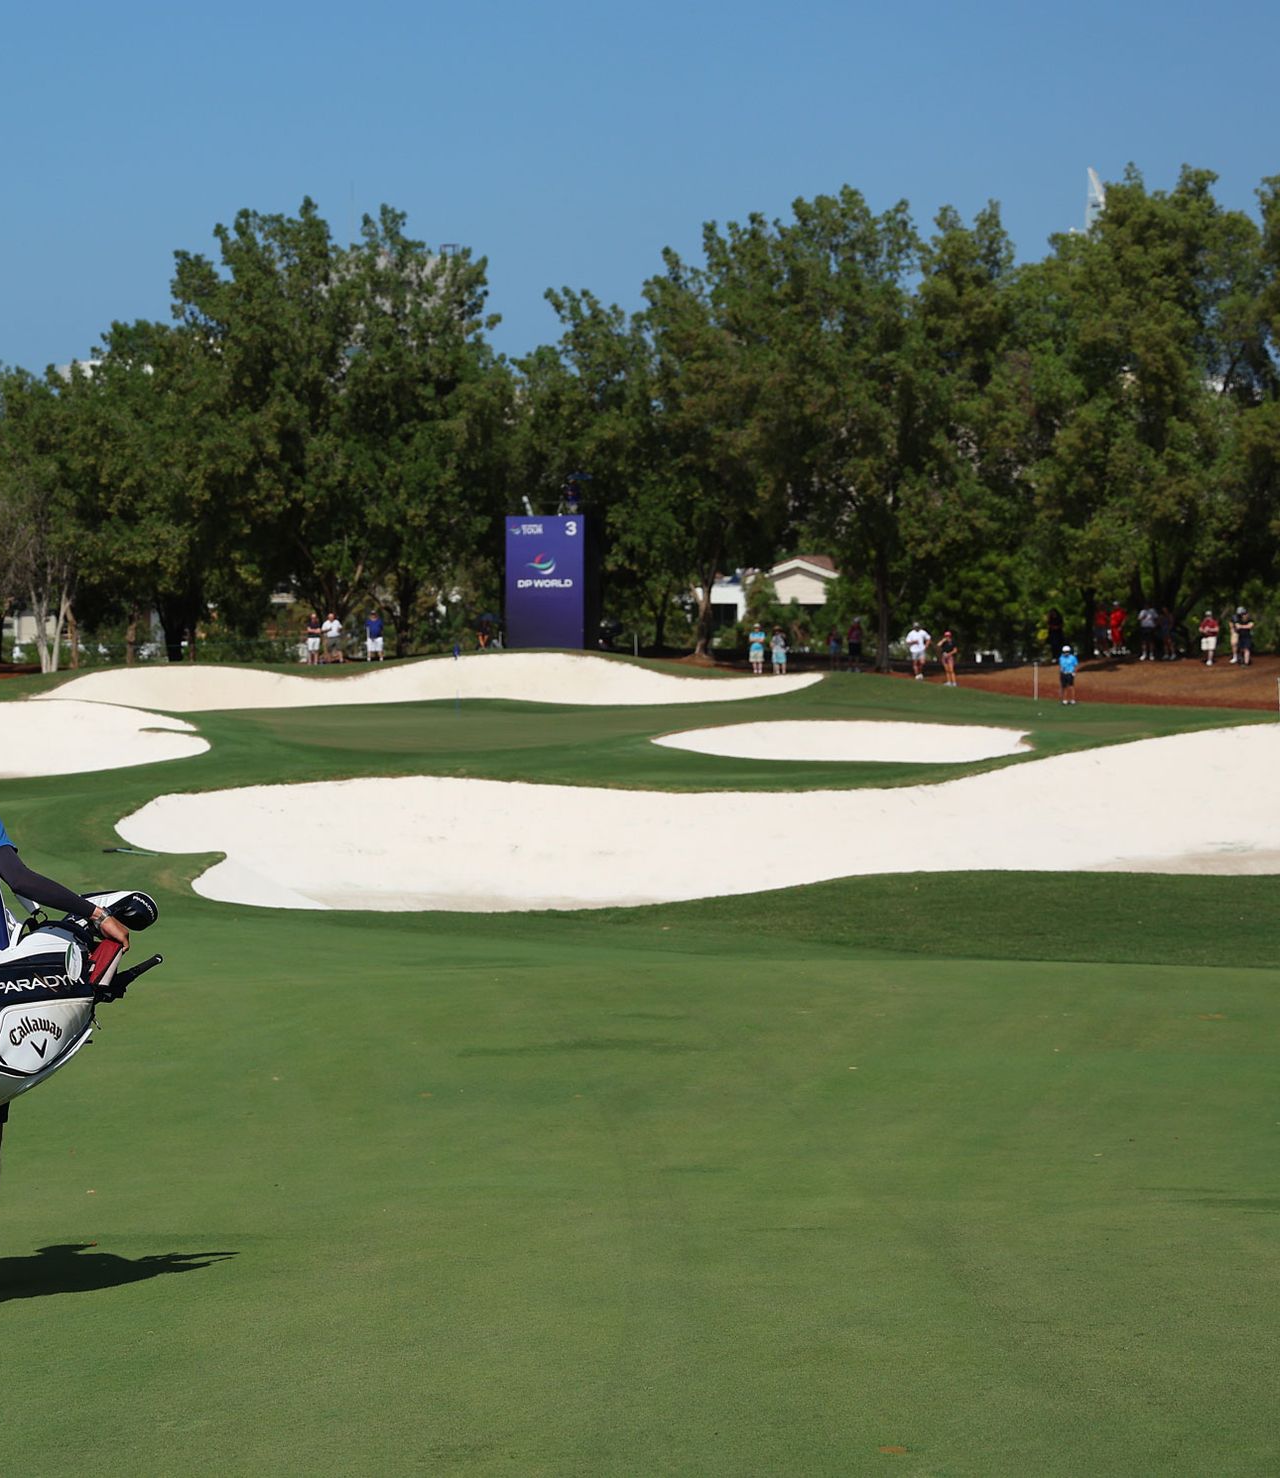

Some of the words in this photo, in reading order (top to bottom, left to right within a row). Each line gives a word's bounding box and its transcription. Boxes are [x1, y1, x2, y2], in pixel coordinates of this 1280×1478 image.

[565, 521, 577, 536] 3
[517, 579, 532, 588] DP
[533, 579, 573, 588] WORLD
[9, 1016, 63, 1046] Callaway
